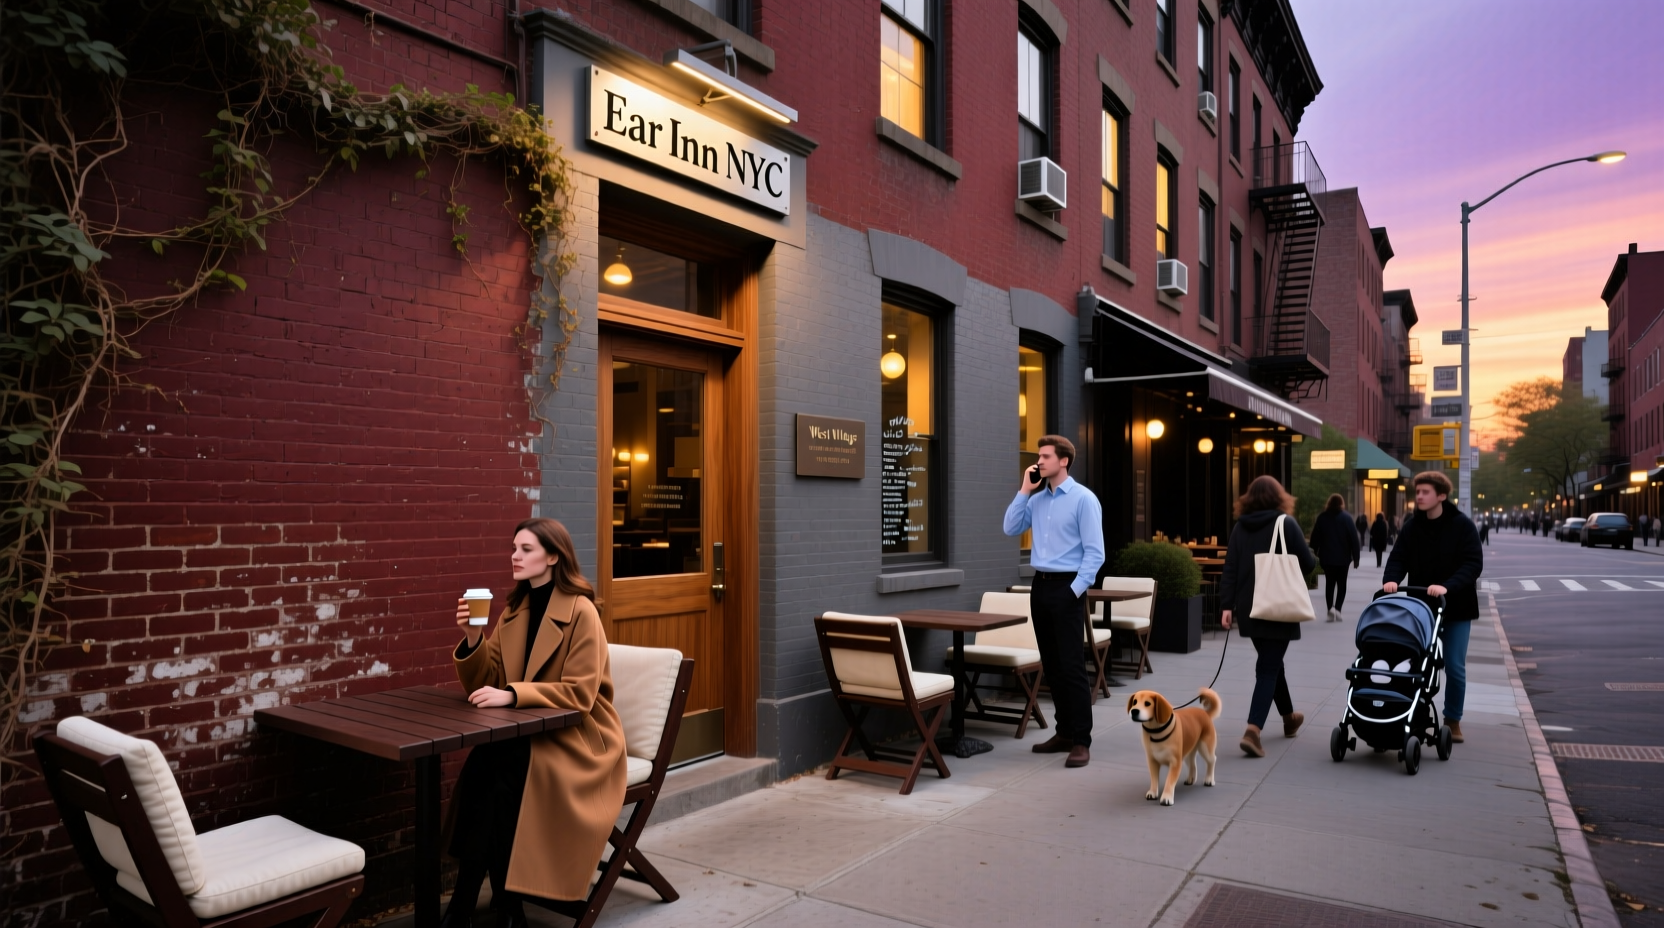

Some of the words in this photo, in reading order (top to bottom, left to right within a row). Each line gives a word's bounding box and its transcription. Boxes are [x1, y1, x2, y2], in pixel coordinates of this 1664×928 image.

[604, 89, 663, 148] Ear
[669, 118, 719, 174] Inn
[726, 142, 783, 198] NYC
